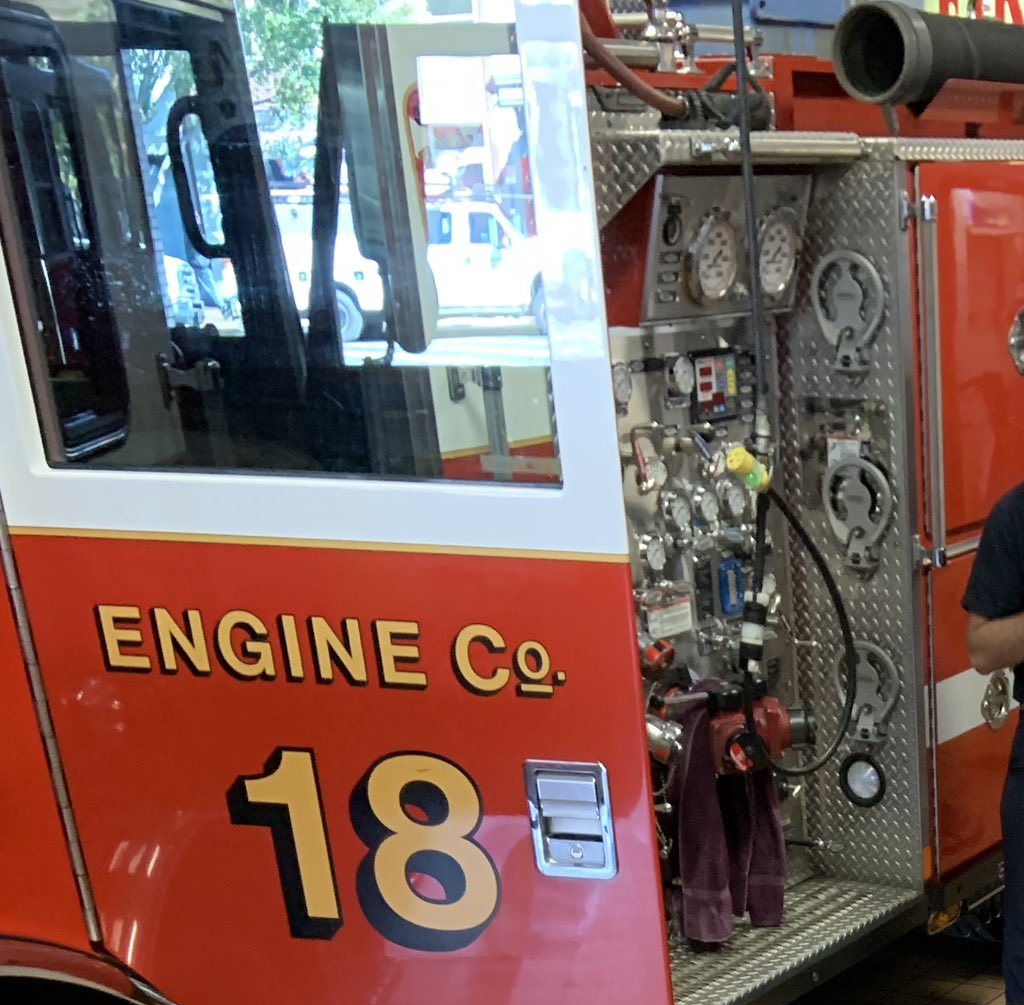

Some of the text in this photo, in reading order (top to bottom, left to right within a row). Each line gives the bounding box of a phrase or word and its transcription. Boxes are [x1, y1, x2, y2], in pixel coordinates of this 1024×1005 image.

[95, 604, 566, 698] ENGINE Co.
[227, 746, 501, 951] 18
